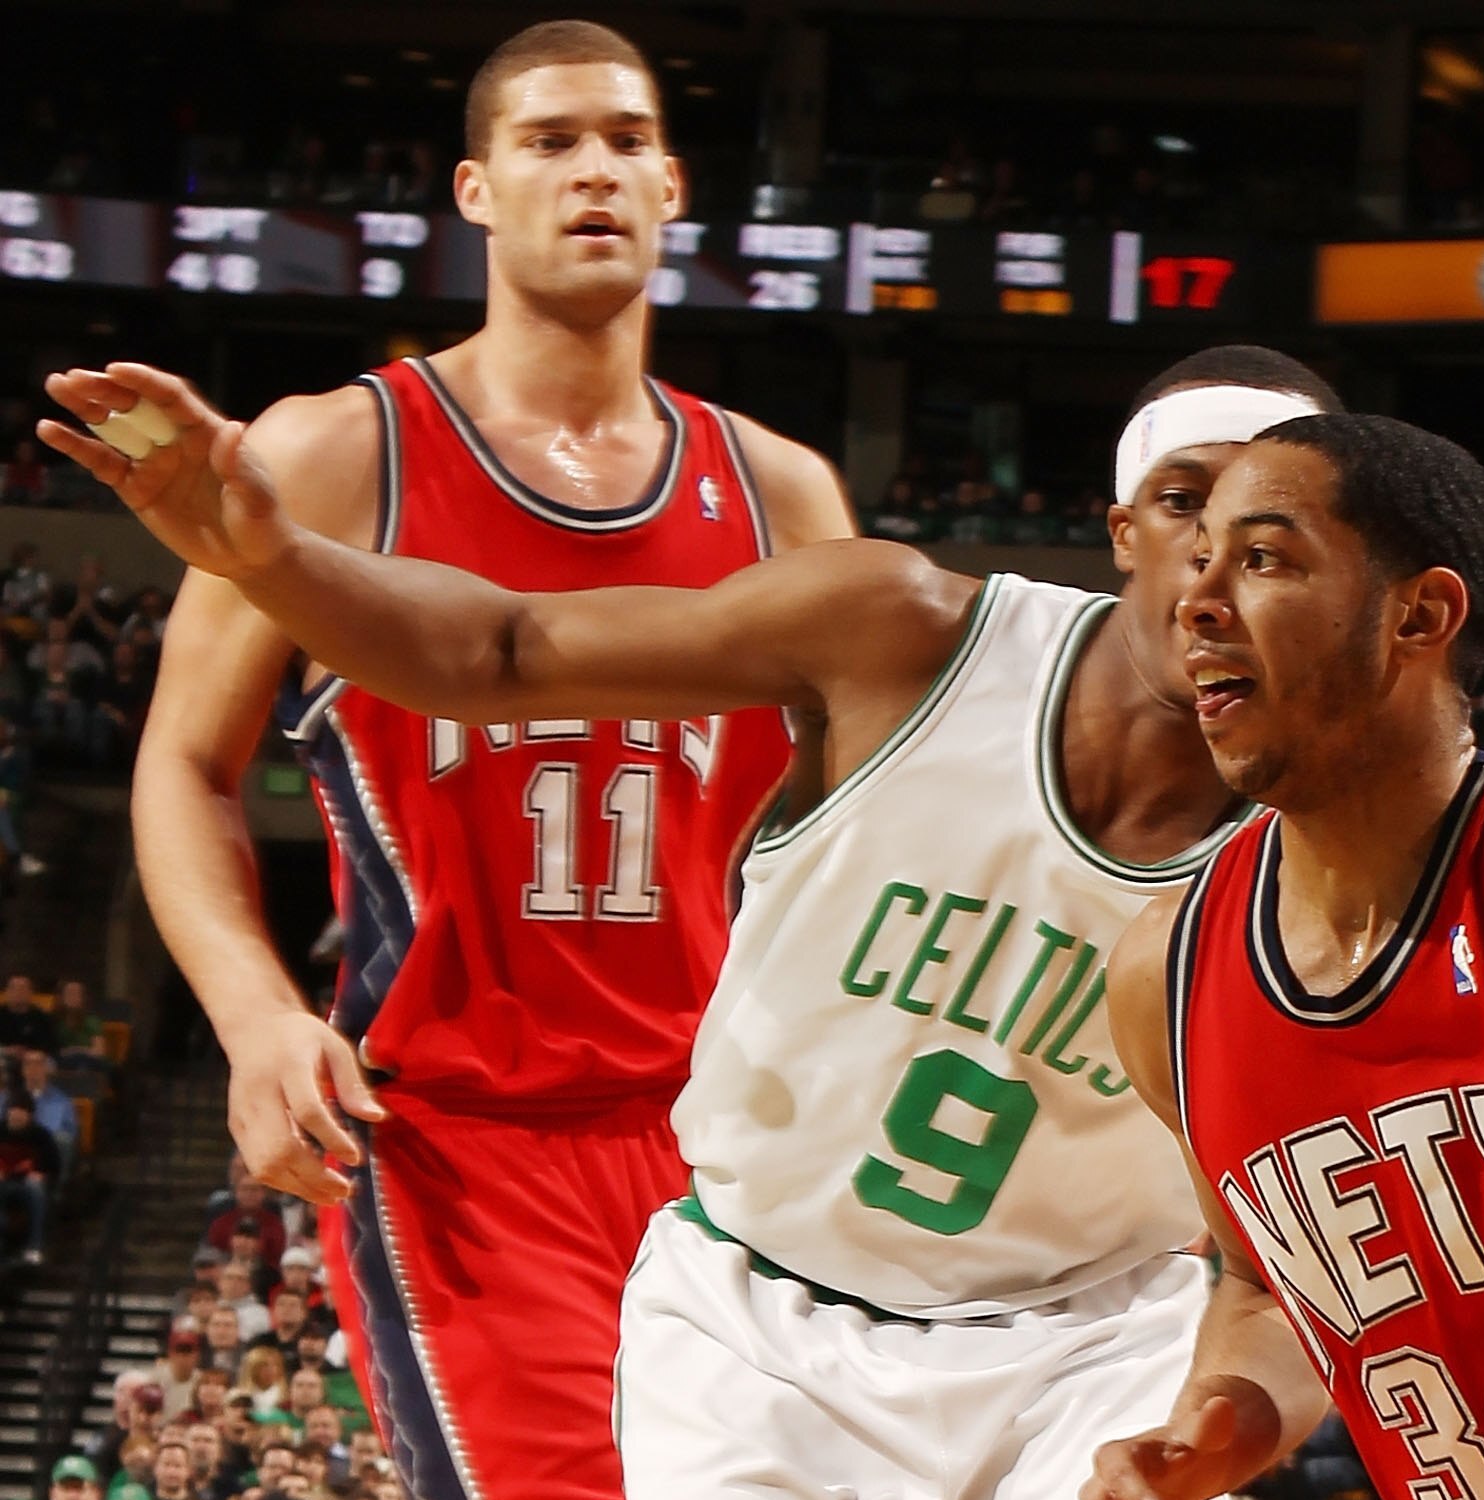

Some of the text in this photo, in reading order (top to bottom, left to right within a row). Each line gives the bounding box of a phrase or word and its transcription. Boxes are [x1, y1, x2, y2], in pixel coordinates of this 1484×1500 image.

[361, 258, 403, 298] 9
[1139, 256, 1233, 307] 17
[521, 762, 662, 922] 11
[851, 1048, 1039, 1236] 9
